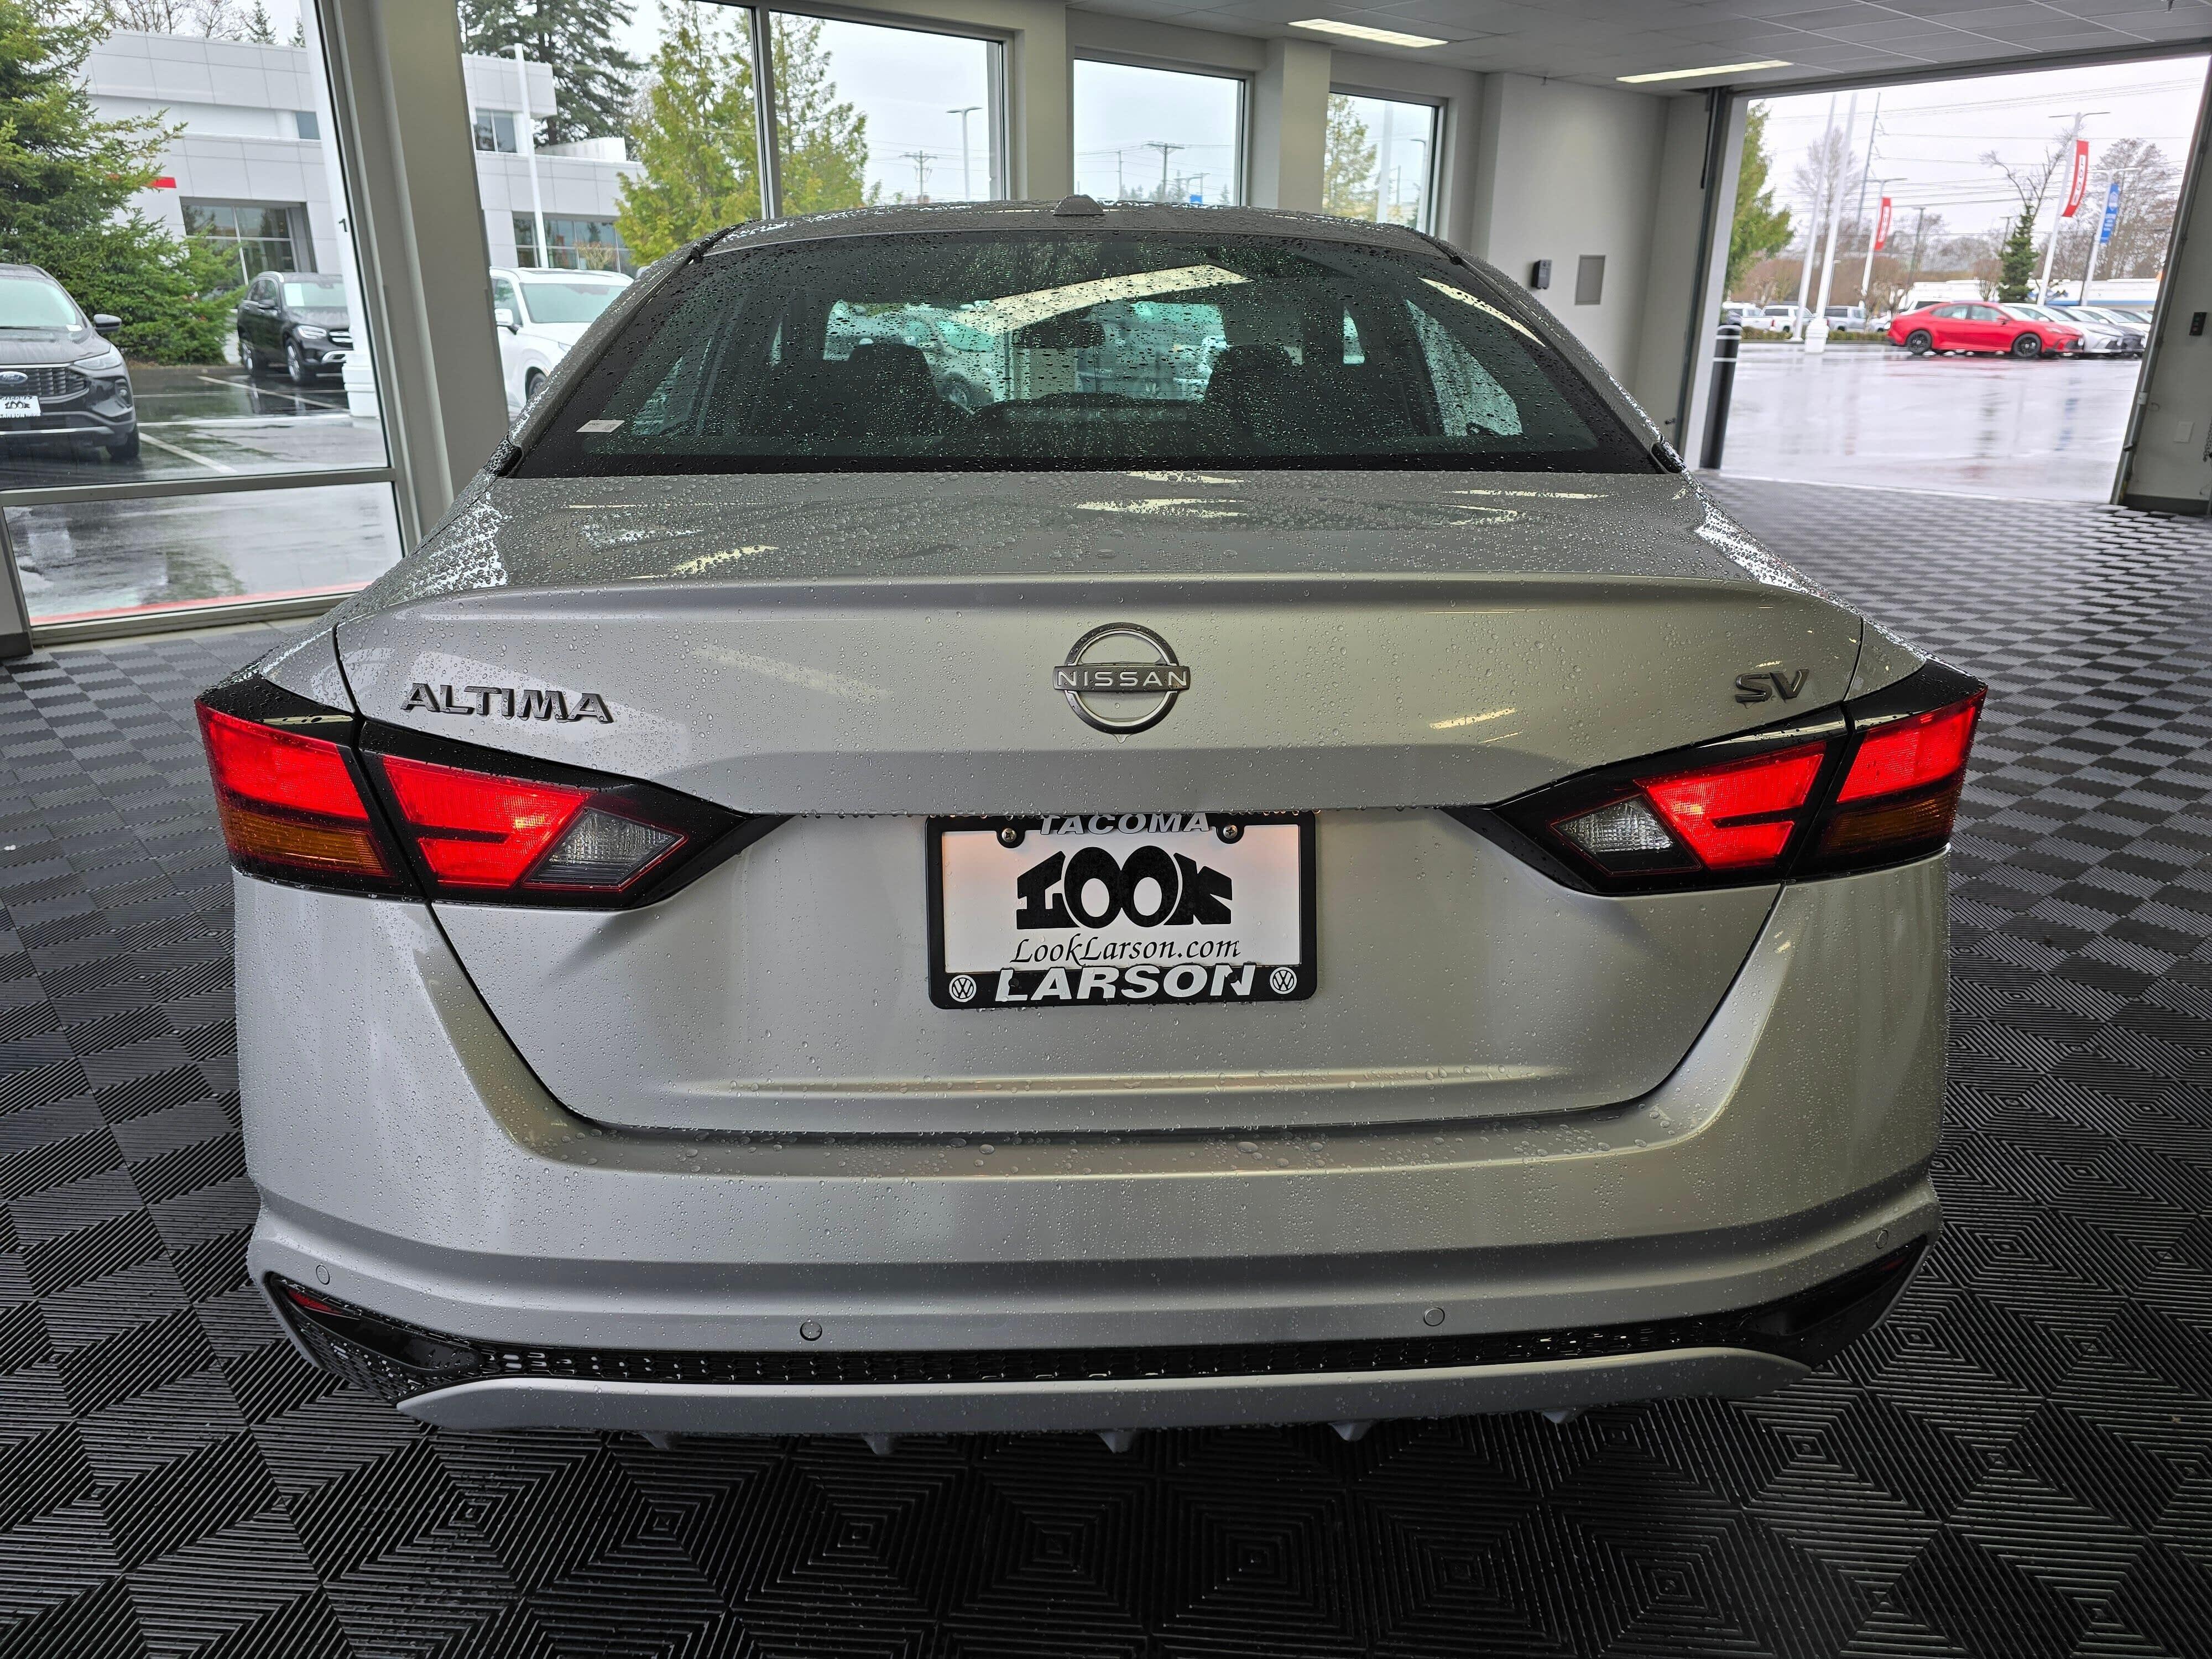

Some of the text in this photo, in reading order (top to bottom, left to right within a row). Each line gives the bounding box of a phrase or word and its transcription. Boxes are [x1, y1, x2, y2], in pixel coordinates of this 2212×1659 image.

[1057, 671, 1187, 687] NISSAN
[1735, 668, 1809, 703] SV
[400, 682, 614, 724] ALTIMA
[1040, 812, 1210, 835] TACOMA
[1016, 846, 1233, 930] LOOK
[1010, 933, 1241, 967] LookLarson.com
[995, 963, 1257, 1002] LARSON
